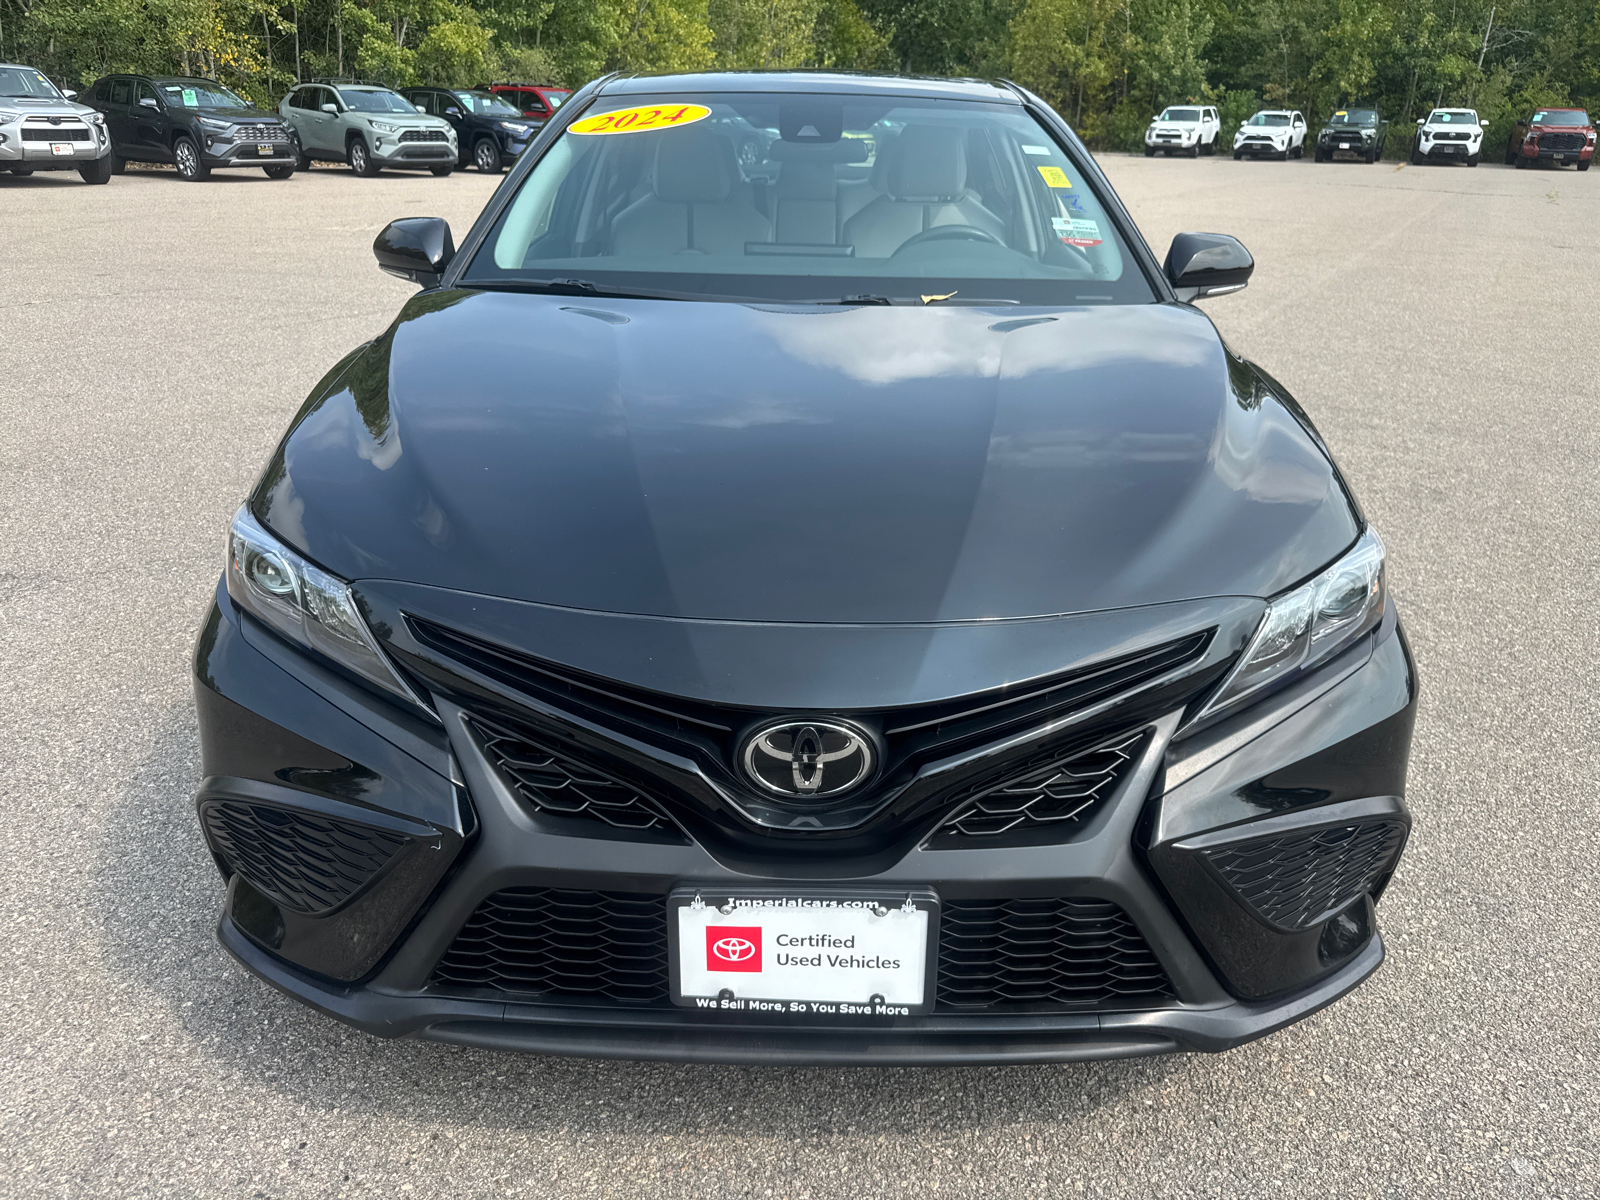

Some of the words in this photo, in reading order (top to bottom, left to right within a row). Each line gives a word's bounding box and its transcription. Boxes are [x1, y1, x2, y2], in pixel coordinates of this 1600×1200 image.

[588, 106, 690, 133] 2024
[728, 898, 878, 909] Imperialcars.com
[776, 934, 855, 948] Certified
[776, 953, 821, 967] Used
[827, 955, 900, 969] Vehicles
[696, 998, 717, 1008] We
[721, 999, 745, 1010] Sell
[749, 1001, 786, 1013] More,
[790, 1002, 806, 1011] So
[811, 1003, 836, 1013] You
[840, 1004, 871, 1014] Save
[875, 1005, 909, 1015] More
